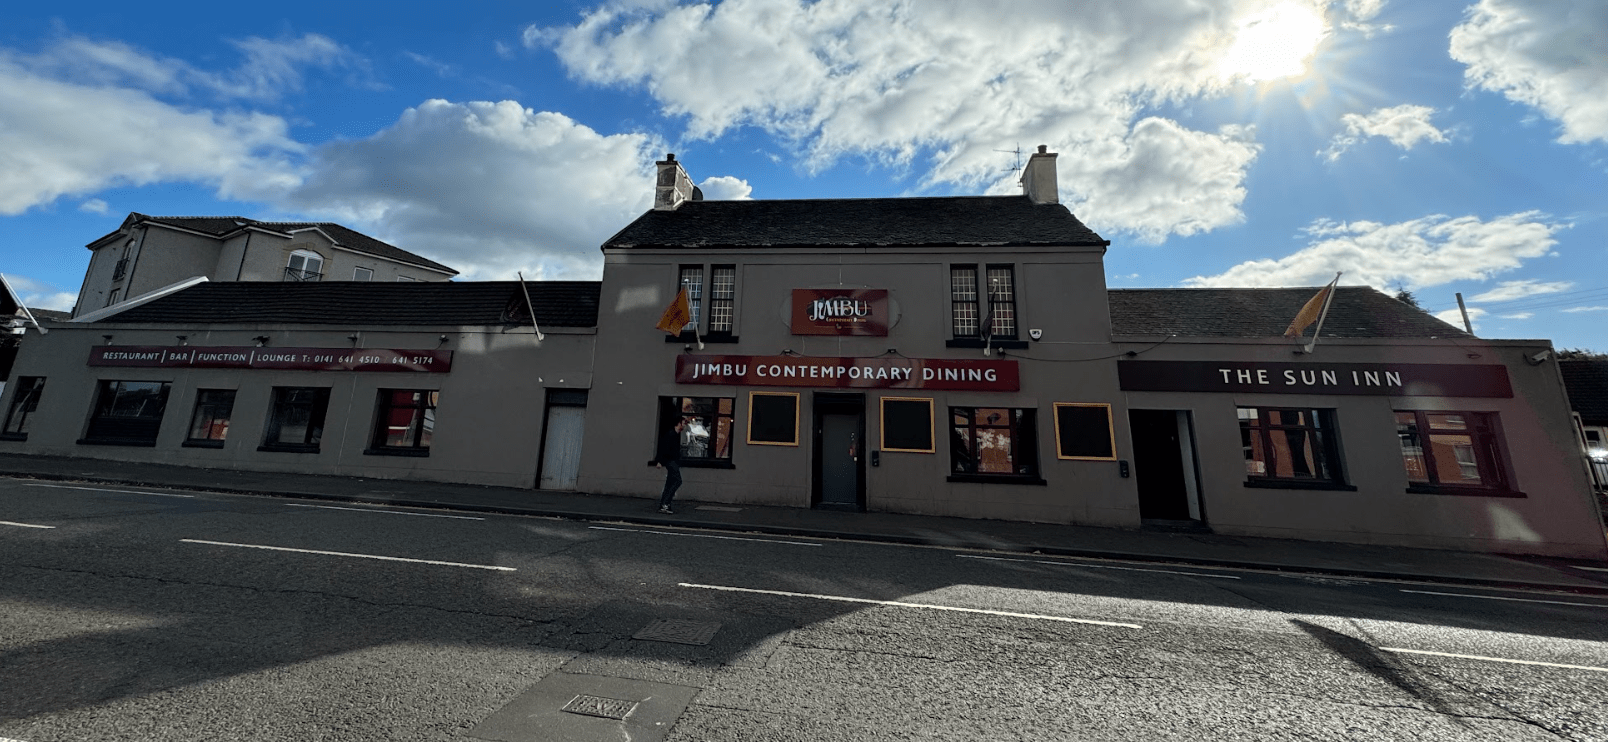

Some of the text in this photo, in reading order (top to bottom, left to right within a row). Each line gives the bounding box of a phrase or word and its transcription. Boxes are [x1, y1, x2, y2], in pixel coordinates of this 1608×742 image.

[809, 300, 867, 321] JIMBU
[102, 352, 433, 365] RESTAURANT BAR FUNCTION LOUNGE T: 0141 641 4510 641 5174
[692, 363, 997, 382] JIMBU CONTEMPORARY DINING
[1218, 369, 1402, 387] THE SUN INN
